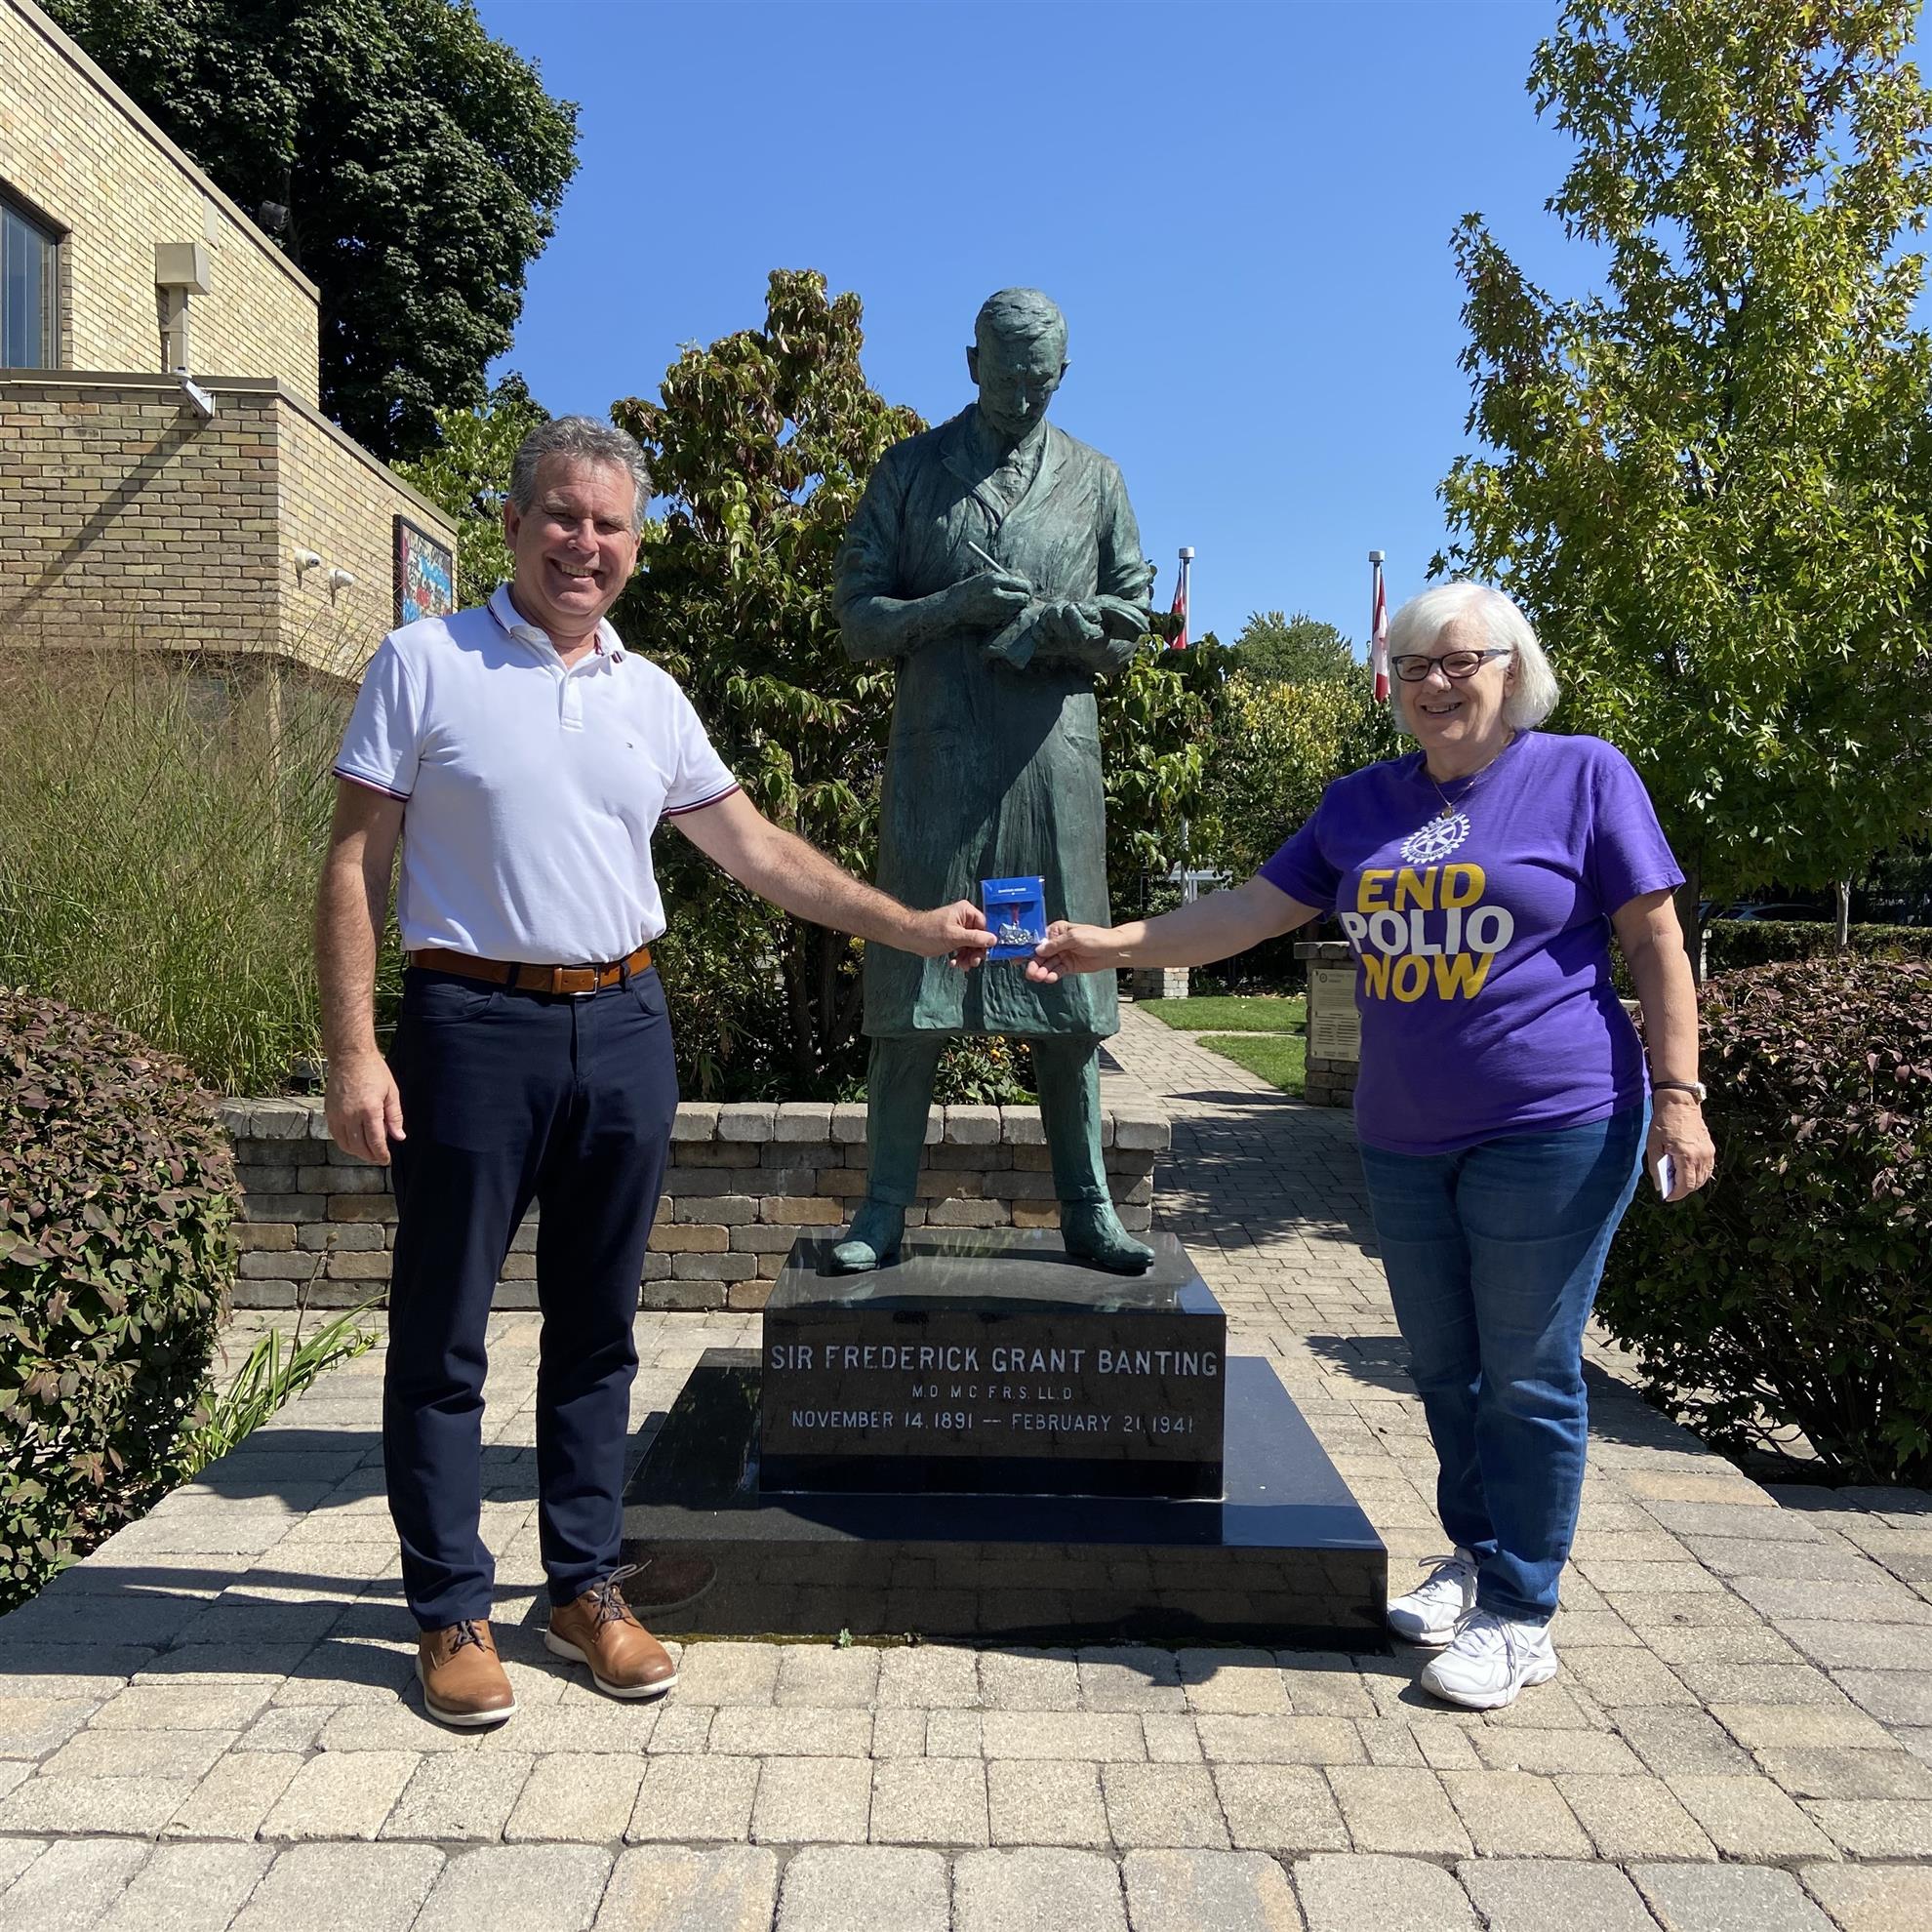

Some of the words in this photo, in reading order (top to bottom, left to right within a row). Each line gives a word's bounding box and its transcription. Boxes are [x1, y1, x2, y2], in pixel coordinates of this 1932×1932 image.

[1357, 863, 1486, 913] END
[1341, 906, 1514, 956] POLIO
[1360, 952, 1495, 1003] NOW
[771, 1345, 813, 1370] SIR
[825, 1345, 980, 1372] FREDERICK
[991, 1347, 1086, 1375] GRANT
[1098, 1348, 1218, 1377] BANTING
[792, 1410, 893, 1429] NOVEMBER
[935, 1412, 973, 1429] 1891
[1012, 1413, 1112, 1432] FEBRUARY
[1152, 1416, 1193, 1434] 1941
